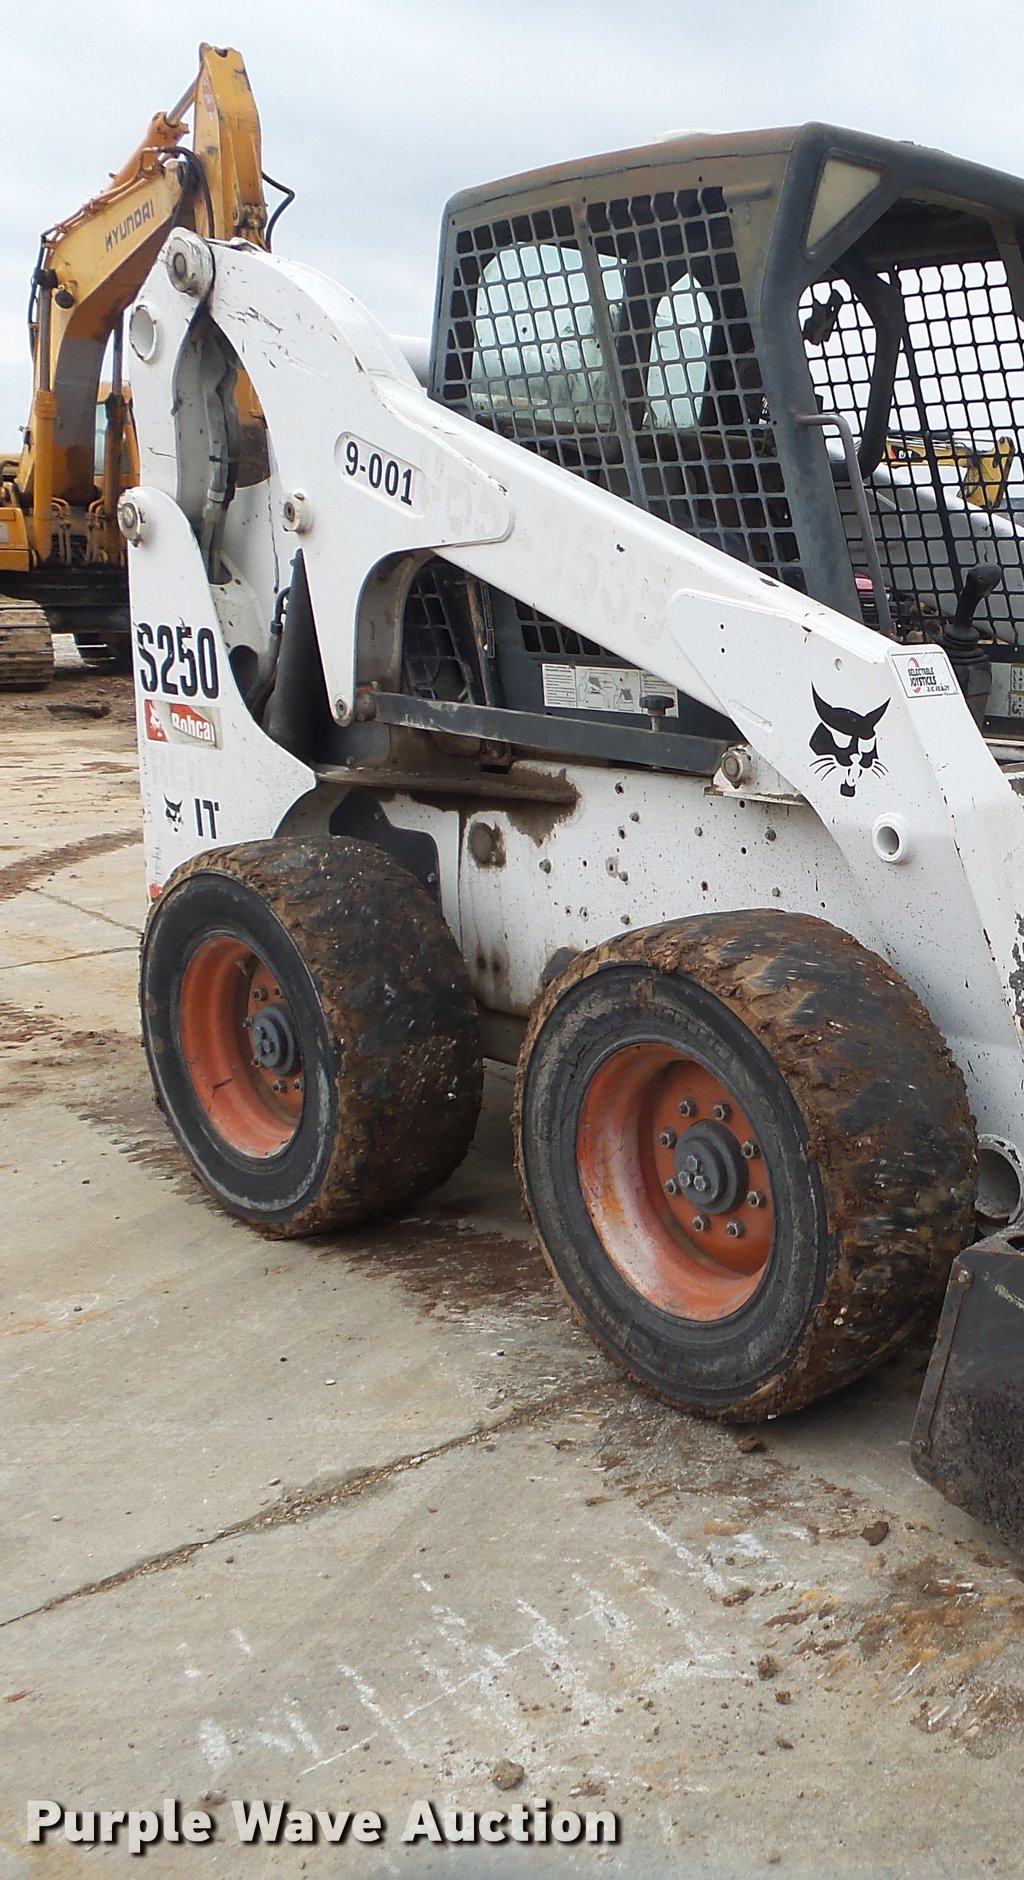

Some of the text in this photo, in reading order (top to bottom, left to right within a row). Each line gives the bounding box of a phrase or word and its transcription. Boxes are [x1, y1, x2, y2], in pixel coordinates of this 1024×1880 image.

[104, 198, 155, 254] HYUNDAI
[345, 440, 413, 506] 9-001
[136, 621, 219, 700] S250
